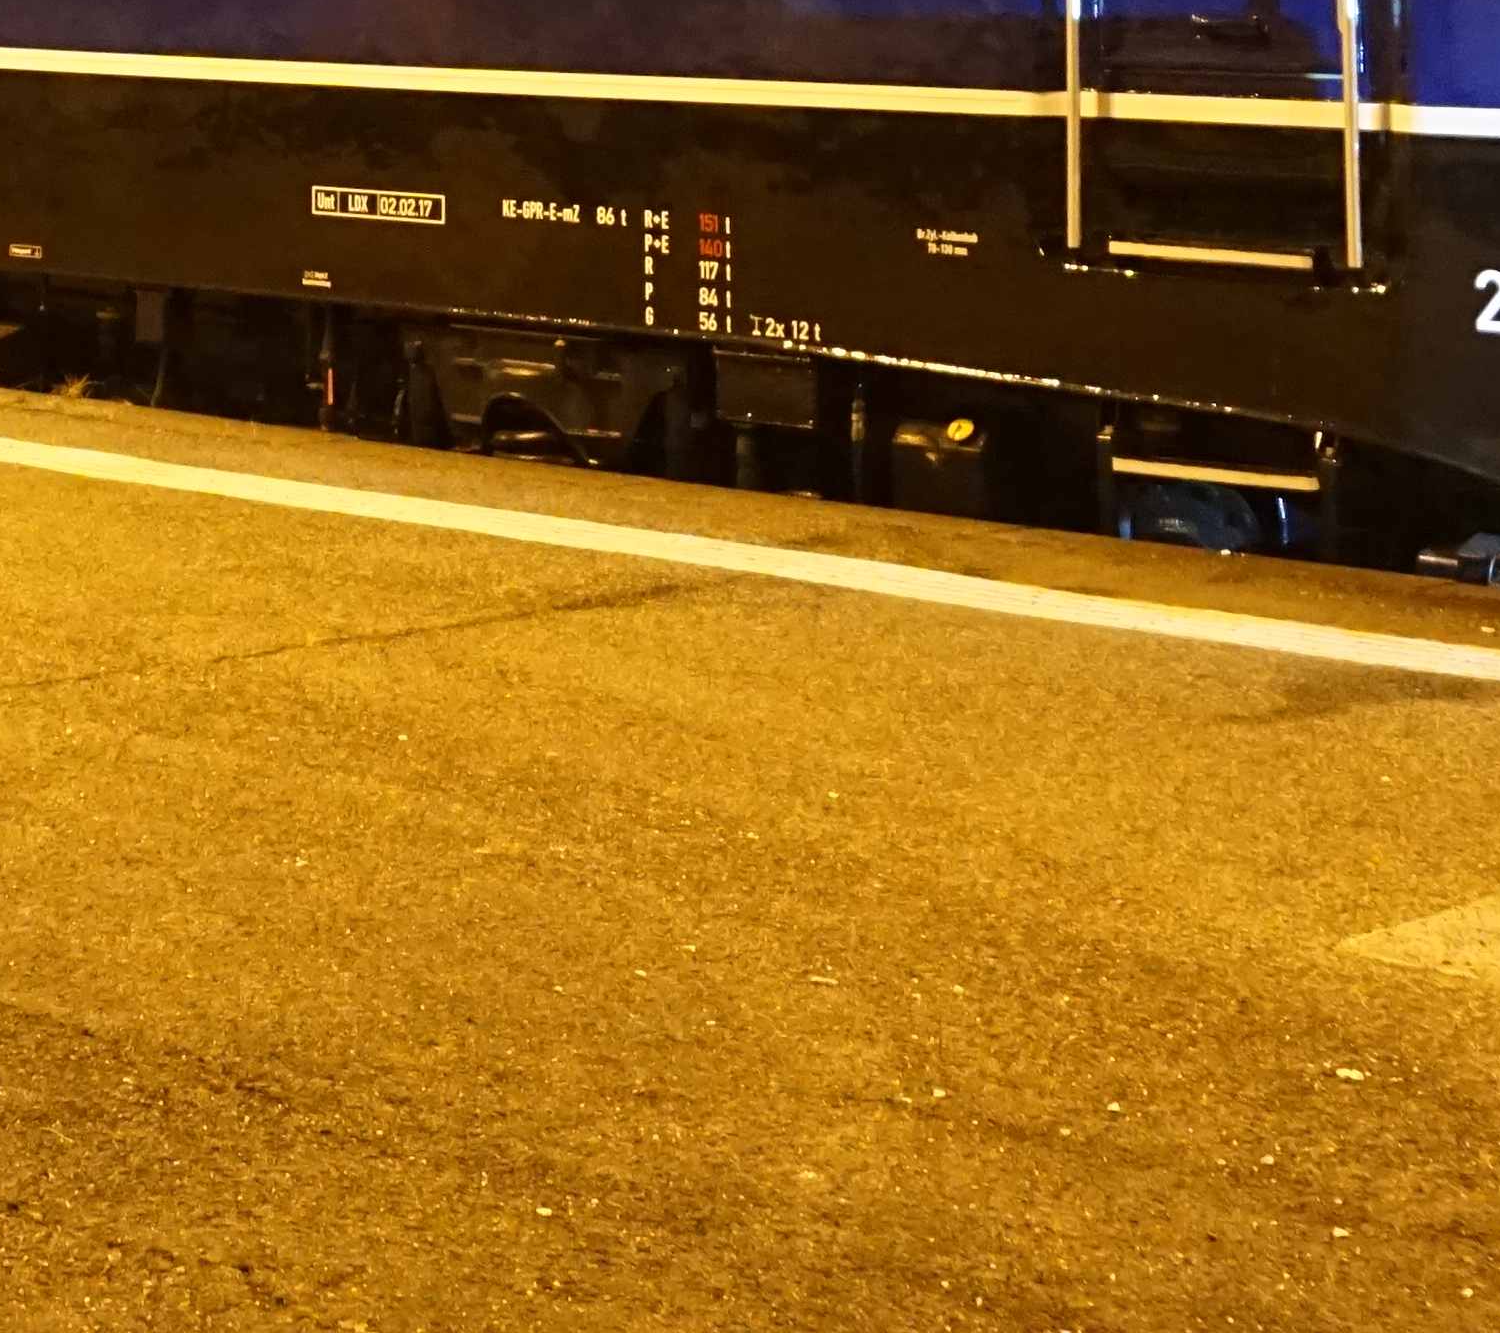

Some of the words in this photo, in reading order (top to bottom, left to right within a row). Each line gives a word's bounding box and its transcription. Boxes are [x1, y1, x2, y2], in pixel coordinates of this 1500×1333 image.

[316, 192, 336, 210] Unt
[348, 194, 368, 213] LDX
[380, 196, 433, 218] 02.02.17
[502, 199, 580, 223] KE-GPR-E-mZ
[596, 205, 616, 226] 86
[621, 208, 628, 227] t
[699, 213, 719, 233] 151
[699, 238, 724, 258] 140
[644, 255, 654, 275] R
[699, 260, 719, 280] 117
[645, 282, 654, 301] P
[699, 287, 718, 307] 84
[645, 307, 654, 326] G
[699, 311, 718, 331] 56
[765, 317, 785, 338] 2x
[791, 319, 809, 340] 12
[814, 323, 821, 341] t
